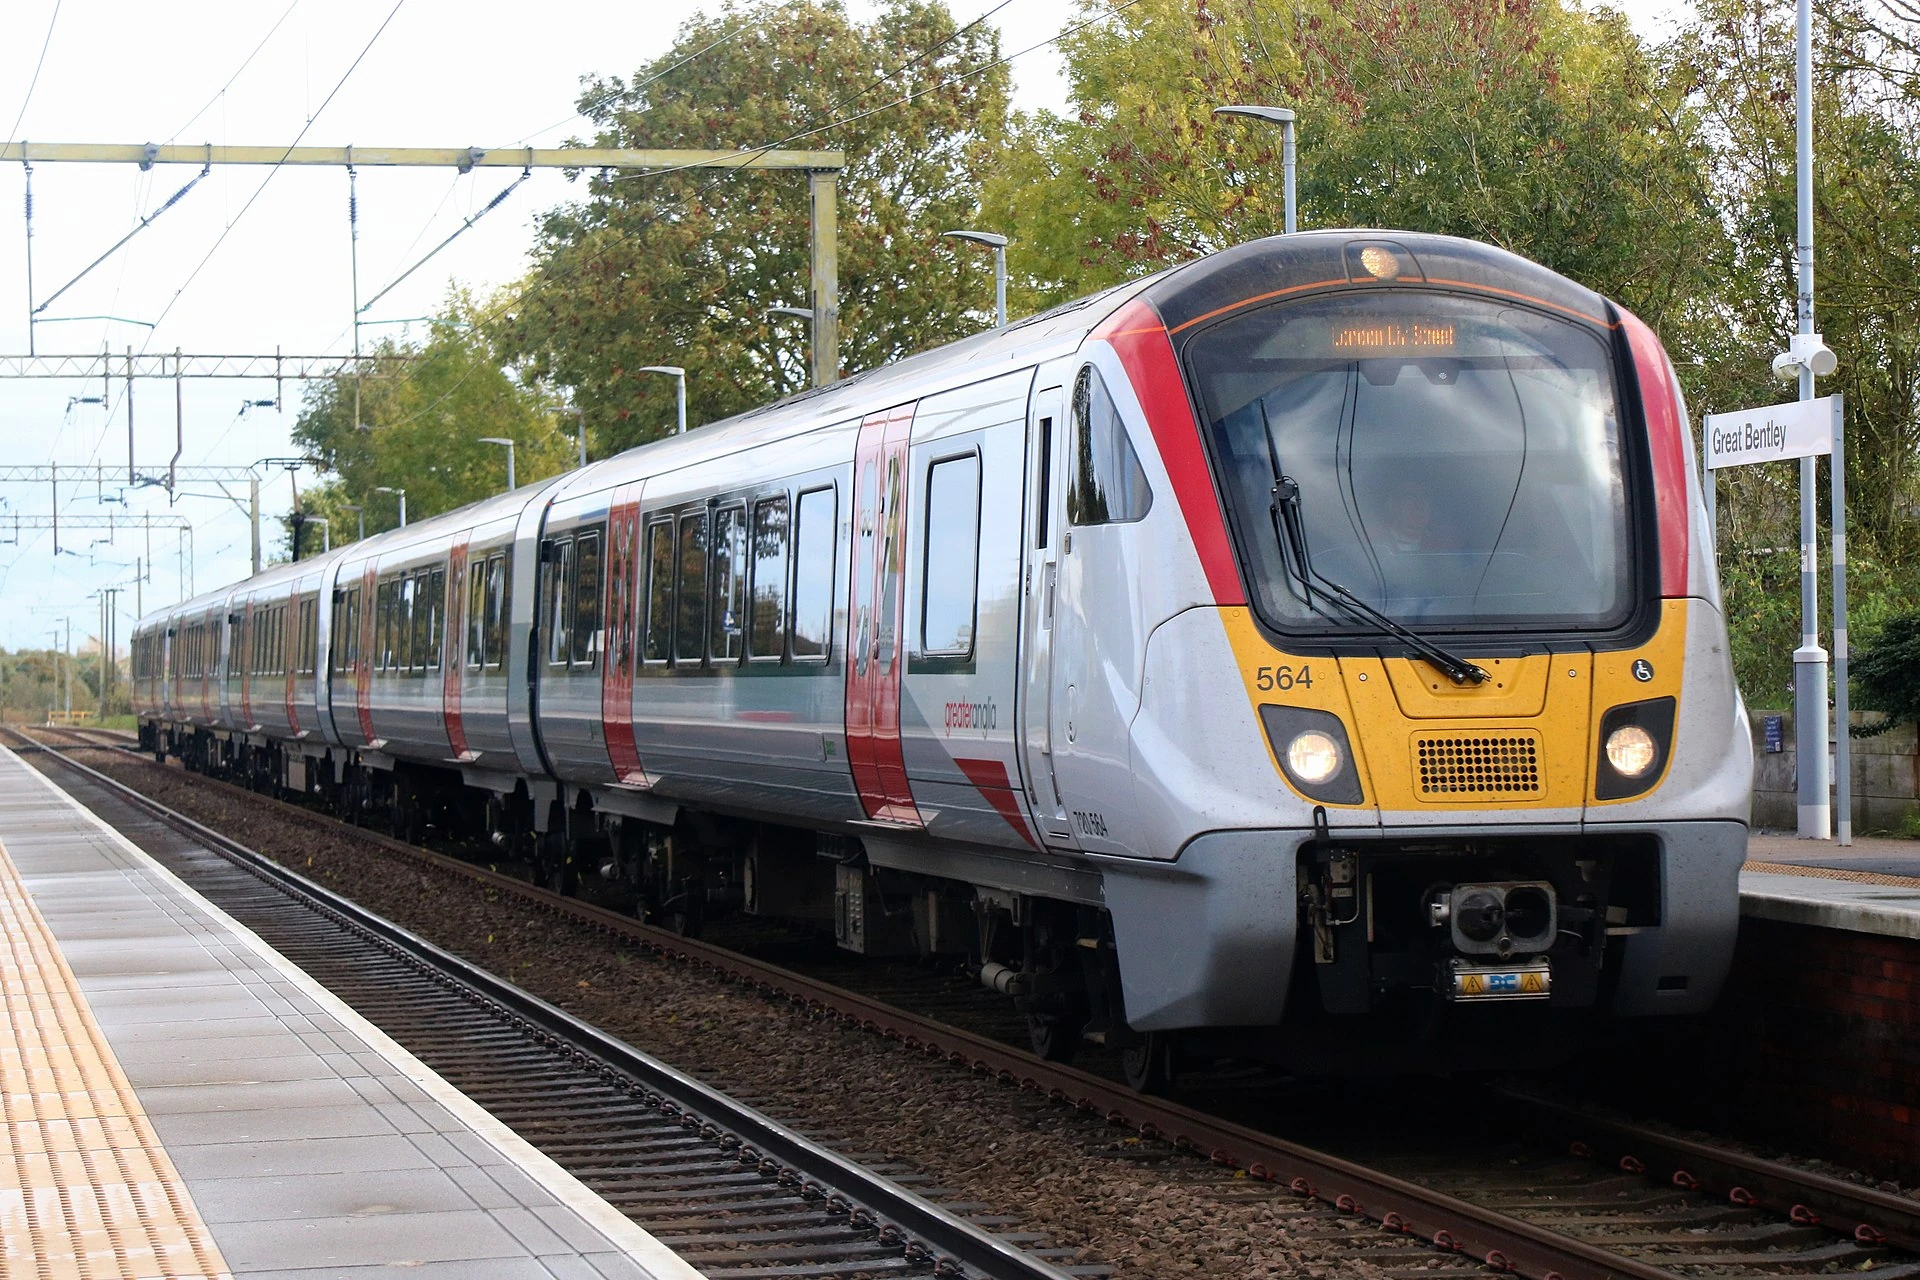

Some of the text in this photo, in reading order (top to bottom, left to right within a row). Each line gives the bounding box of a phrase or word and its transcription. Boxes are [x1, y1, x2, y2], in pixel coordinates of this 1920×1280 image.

[1712, 420, 1787, 455] Great Bentley
[1256, 665, 1313, 691] 564
